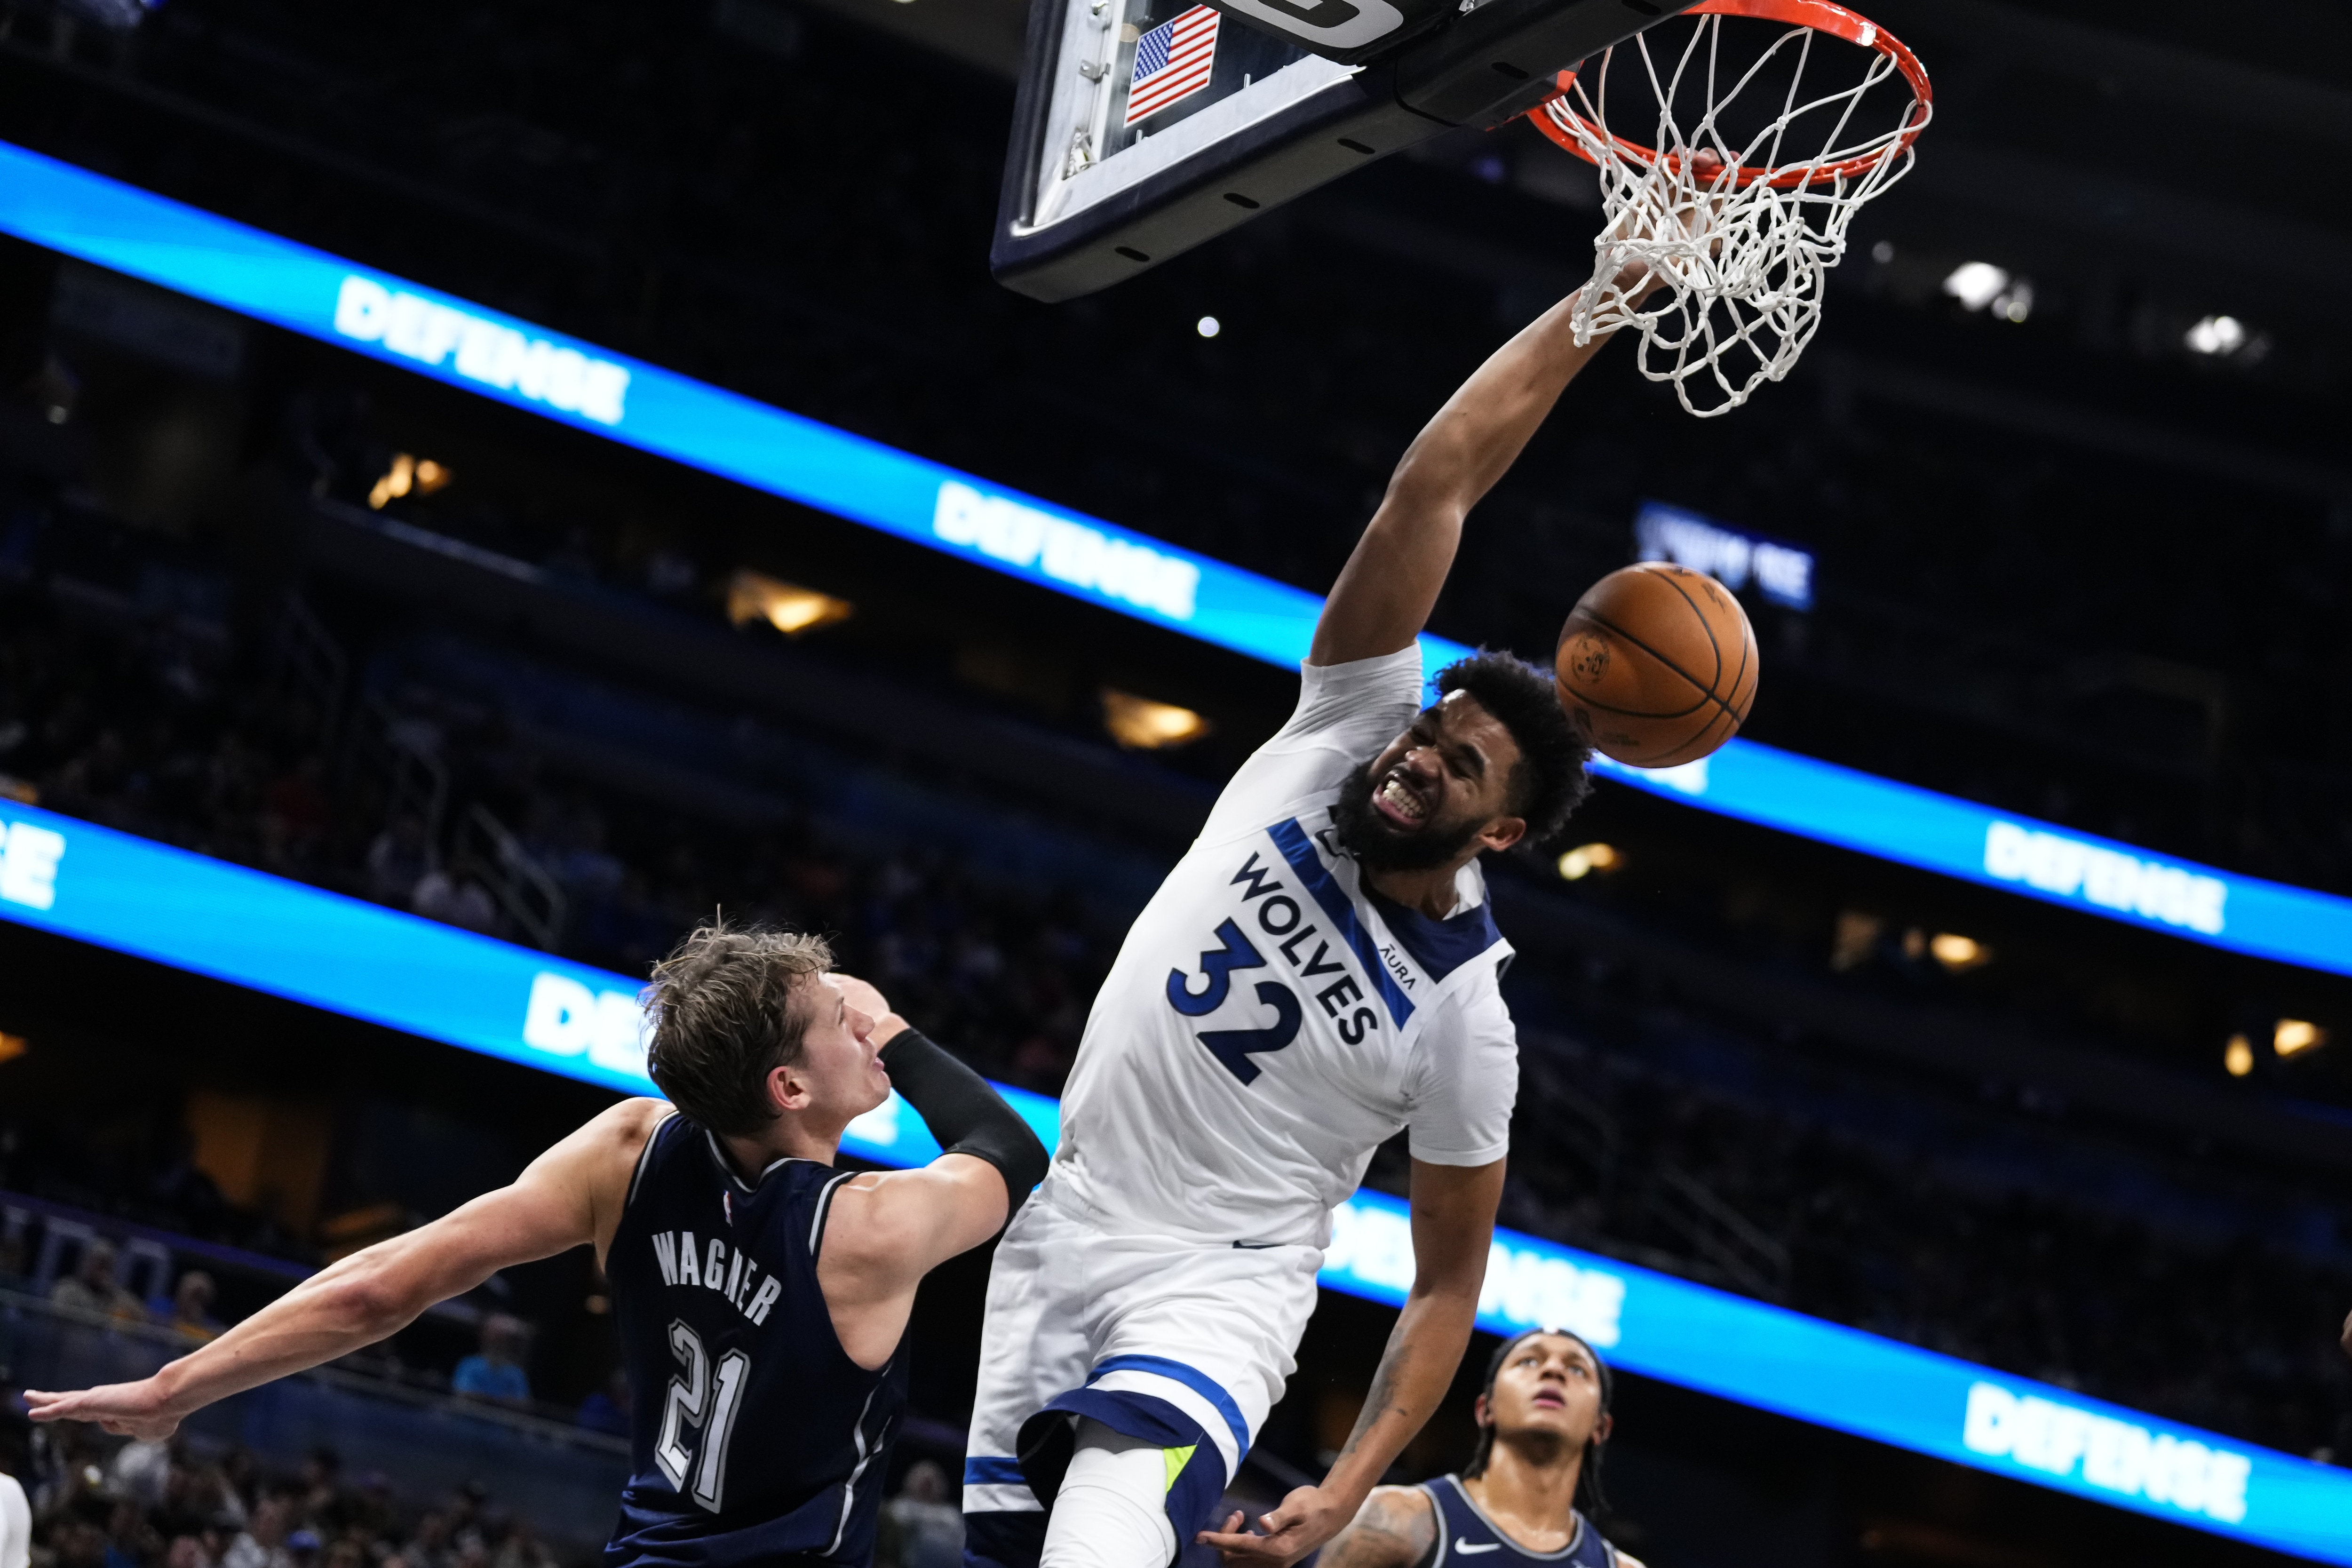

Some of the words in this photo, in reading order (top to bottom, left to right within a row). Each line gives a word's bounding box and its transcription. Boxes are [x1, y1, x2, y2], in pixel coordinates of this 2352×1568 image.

[335, 276, 629, 424] DEFENSE
[934, 482, 1198, 619] DEFENSE
[1229, 851, 1378, 1046] WOLVES
[1984, 821, 2226, 935] DEFENSE
[1166, 916, 1303, 1087] 32
[652, 1230, 782, 1327] WAGNER
[655, 1318, 751, 1514] 21
[1963, 1382, 2250, 1522] DEFENSE
